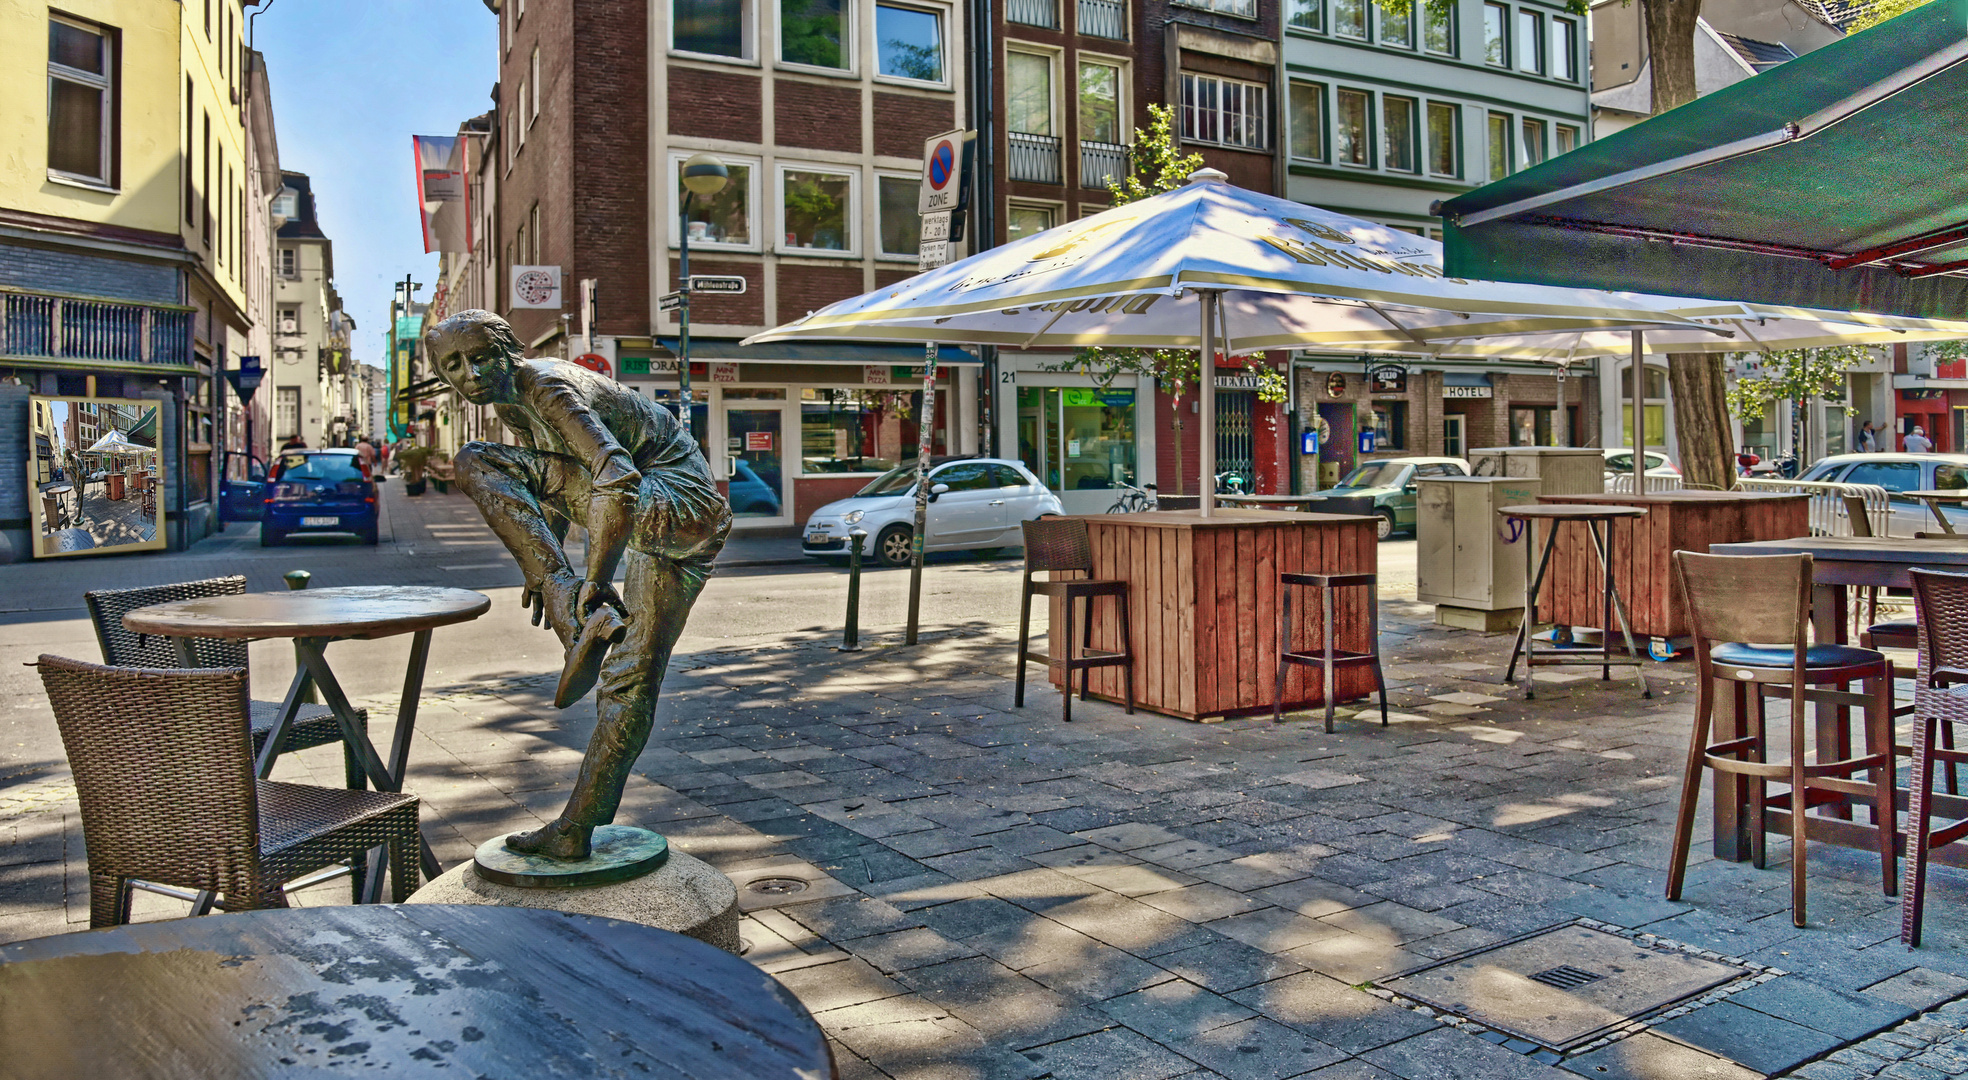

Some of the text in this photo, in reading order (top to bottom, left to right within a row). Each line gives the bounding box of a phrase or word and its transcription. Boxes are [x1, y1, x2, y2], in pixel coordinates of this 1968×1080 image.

[928, 192, 948, 208] ZONE
[924, 216, 949, 227] werktags
[934, 226, 942, 236] 20
[921, 243, 946, 253] Parken nur
[1255, 234, 1496, 285] Bitburg
[624, 361, 705, 372] RISTORATE
[715, 366, 734, 374] MINI
[869, 369, 886, 377] MINI
[1001, 371, 1016, 384] 21
[1377, 371, 1398, 380] JULIO
[713, 374, 736, 383] PIZZA
[867, 376, 887, 384] PIZZA
[1449, 387, 1484, 397] HOTEL
